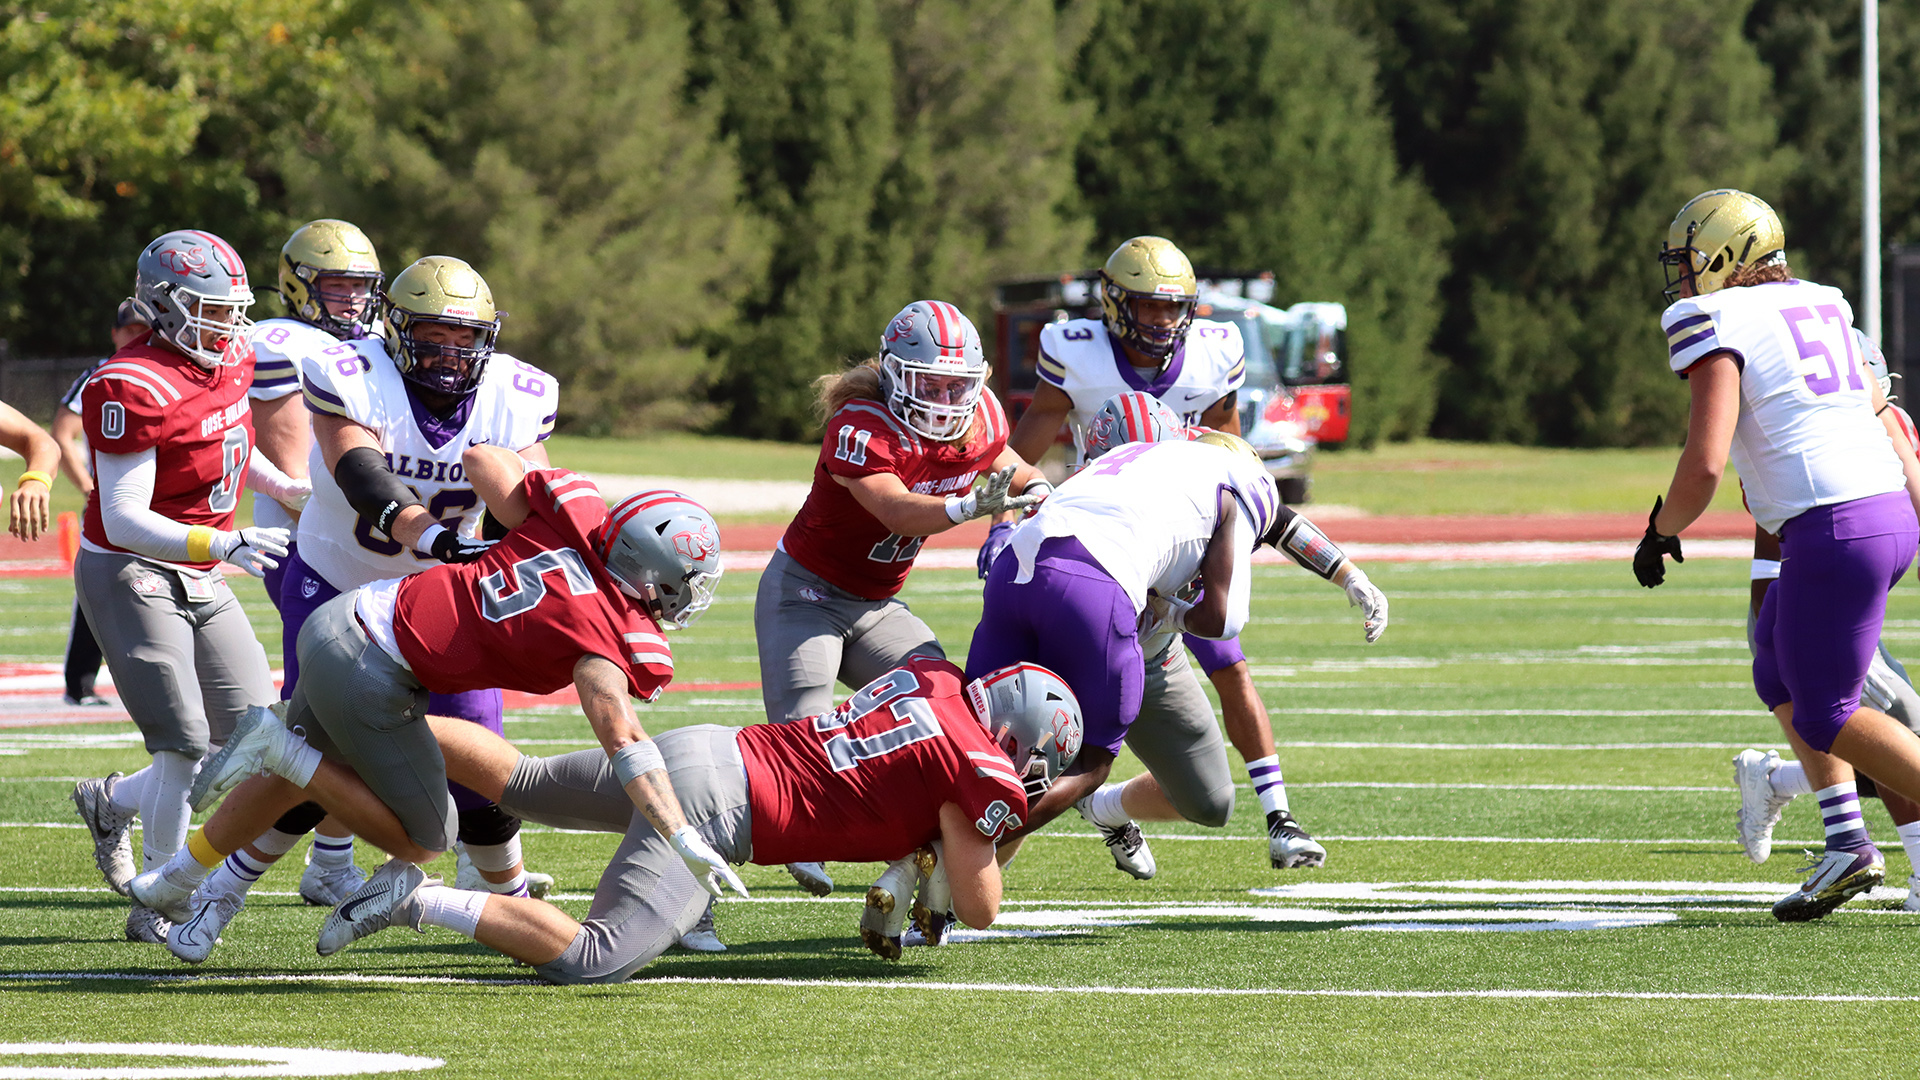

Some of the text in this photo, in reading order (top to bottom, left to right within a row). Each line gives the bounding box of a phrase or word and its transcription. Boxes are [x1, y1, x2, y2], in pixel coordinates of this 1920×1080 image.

[446, 307, 475, 317] Riddell
[1063, 328, 1093, 341] 3
[1200, 327, 1229, 339] 3
[1779, 304, 1865, 397] 57
[322, 343, 373, 376] 66
[102, 401, 125, 440] 0
[834, 424, 873, 467] 11
[208, 423, 249, 513] 0
[909, 469, 979, 495] ROSE-HULMAN
[479, 547, 598, 623] 5
[970, 681, 987, 715] ENGINEERS
[814, 669, 945, 773] 97
